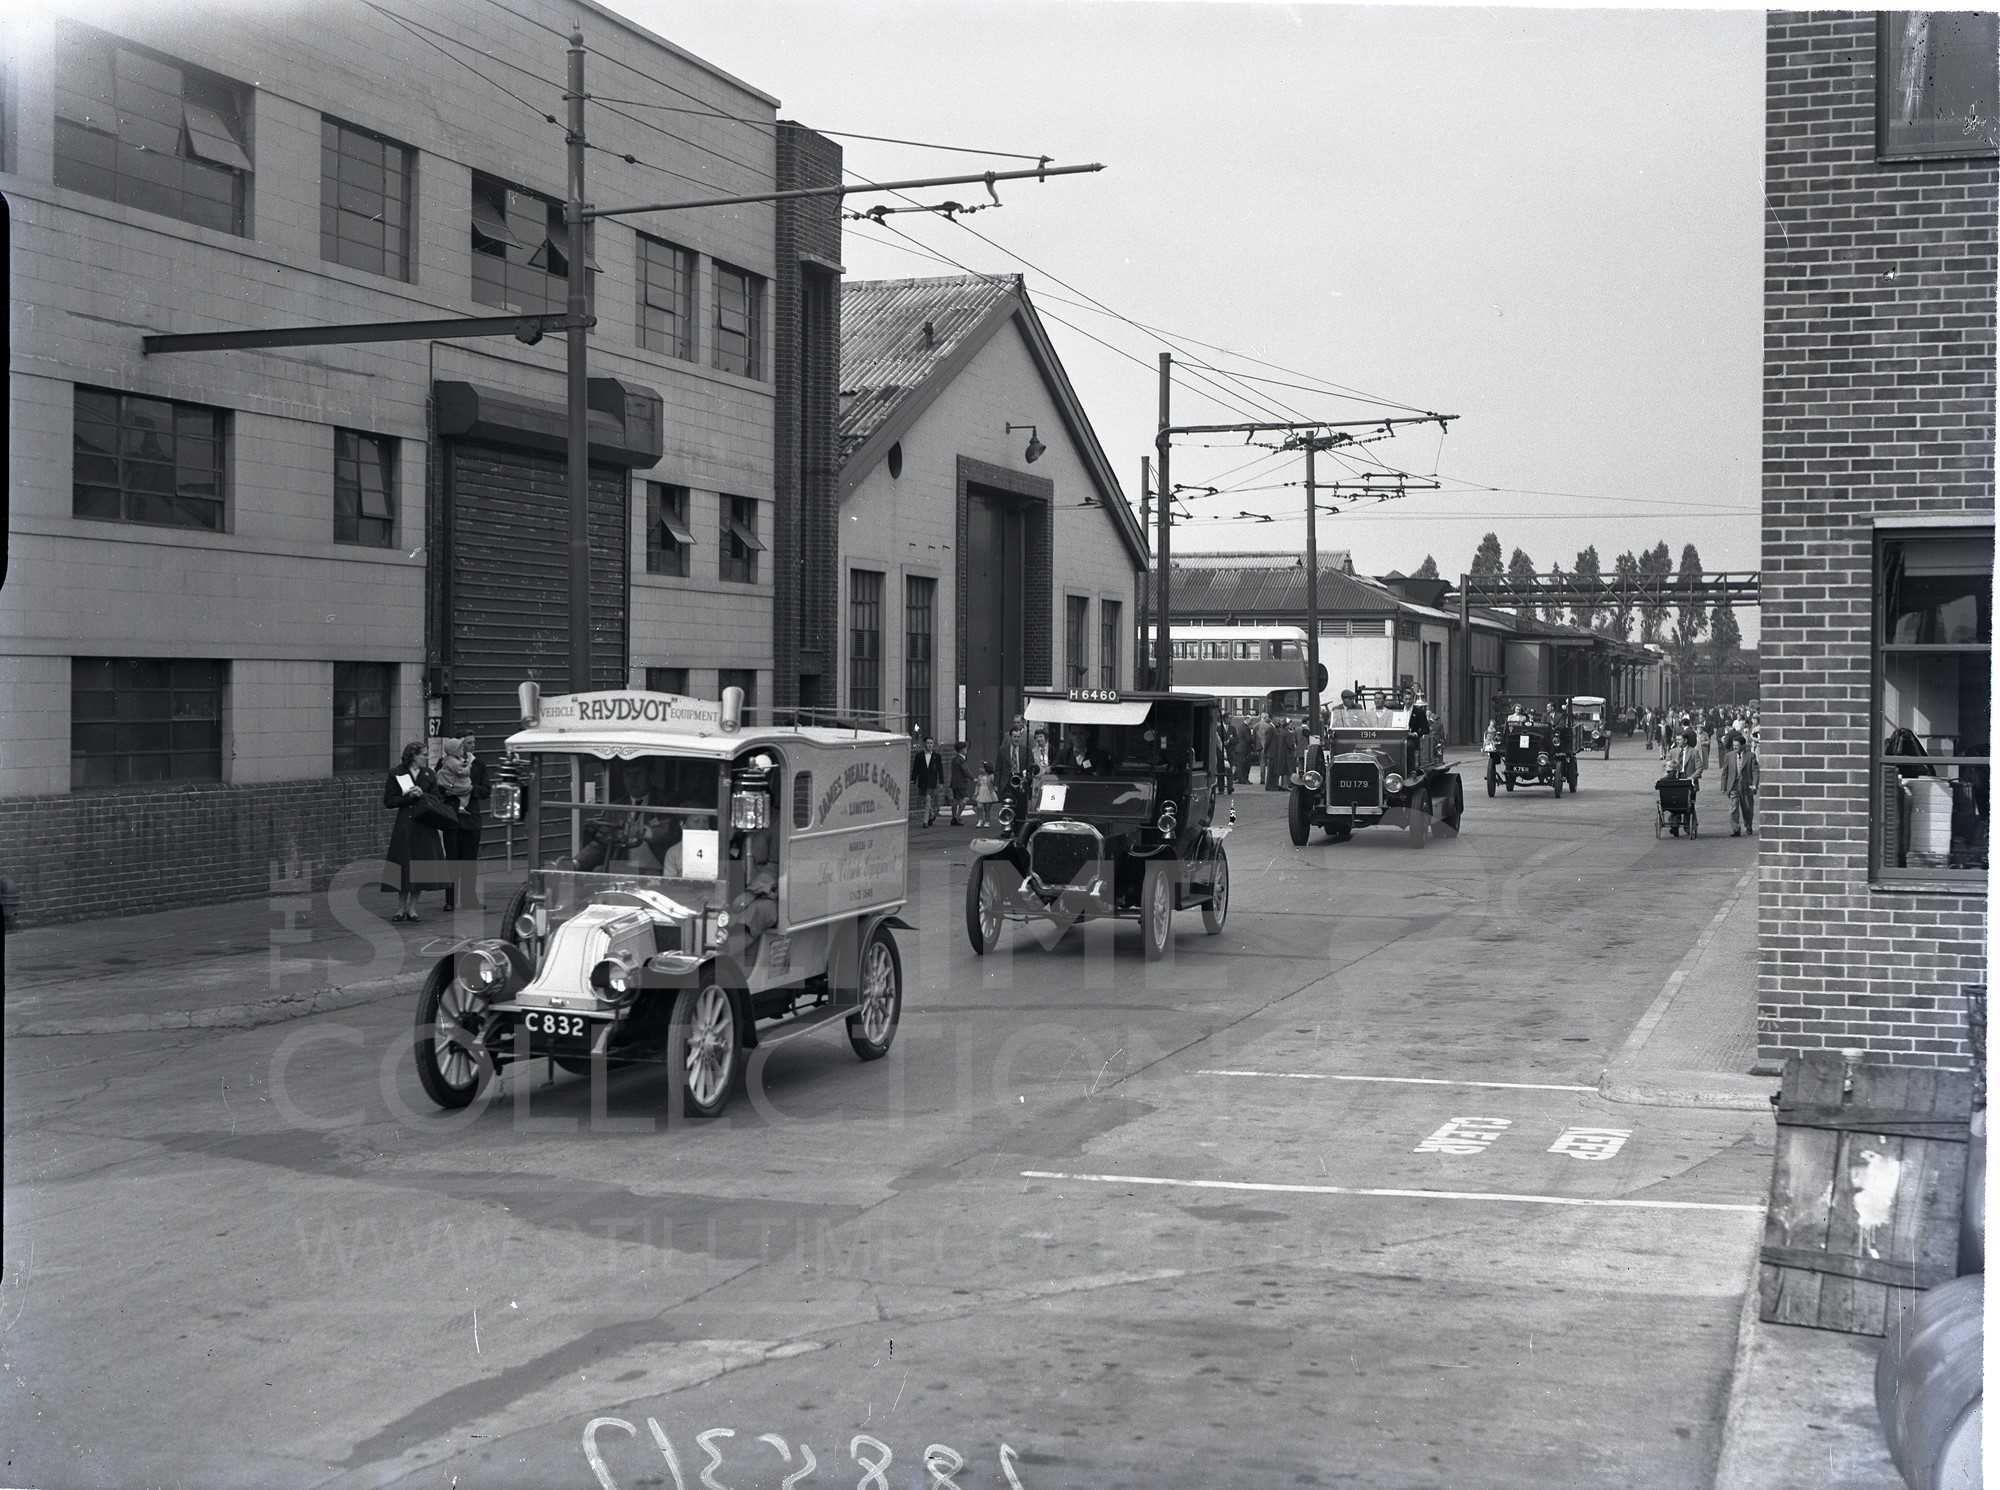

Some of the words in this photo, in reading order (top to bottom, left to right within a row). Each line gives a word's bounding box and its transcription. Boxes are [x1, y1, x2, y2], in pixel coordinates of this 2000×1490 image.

[1069, 689, 1078, 699] H
[1081, 689, 1117, 701] 6460
[540, 706, 576, 718] VEHICLE
[670, 707, 720, 722] EQUIPMENT
[428, 718, 441, 736] 67
[1360, 730, 1377, 740] 1914
[1352, 780, 1369, 788] 179
[818, 775, 843, 825] JAMES
[695, 848, 704, 860] 4
[525, 1012, 539, 1032] C
[543, 1014, 584, 1037] 832
[1413, 1116, 1513, 1155] CLEAR
[1547, 1126, 1633, 1161] KEEP
